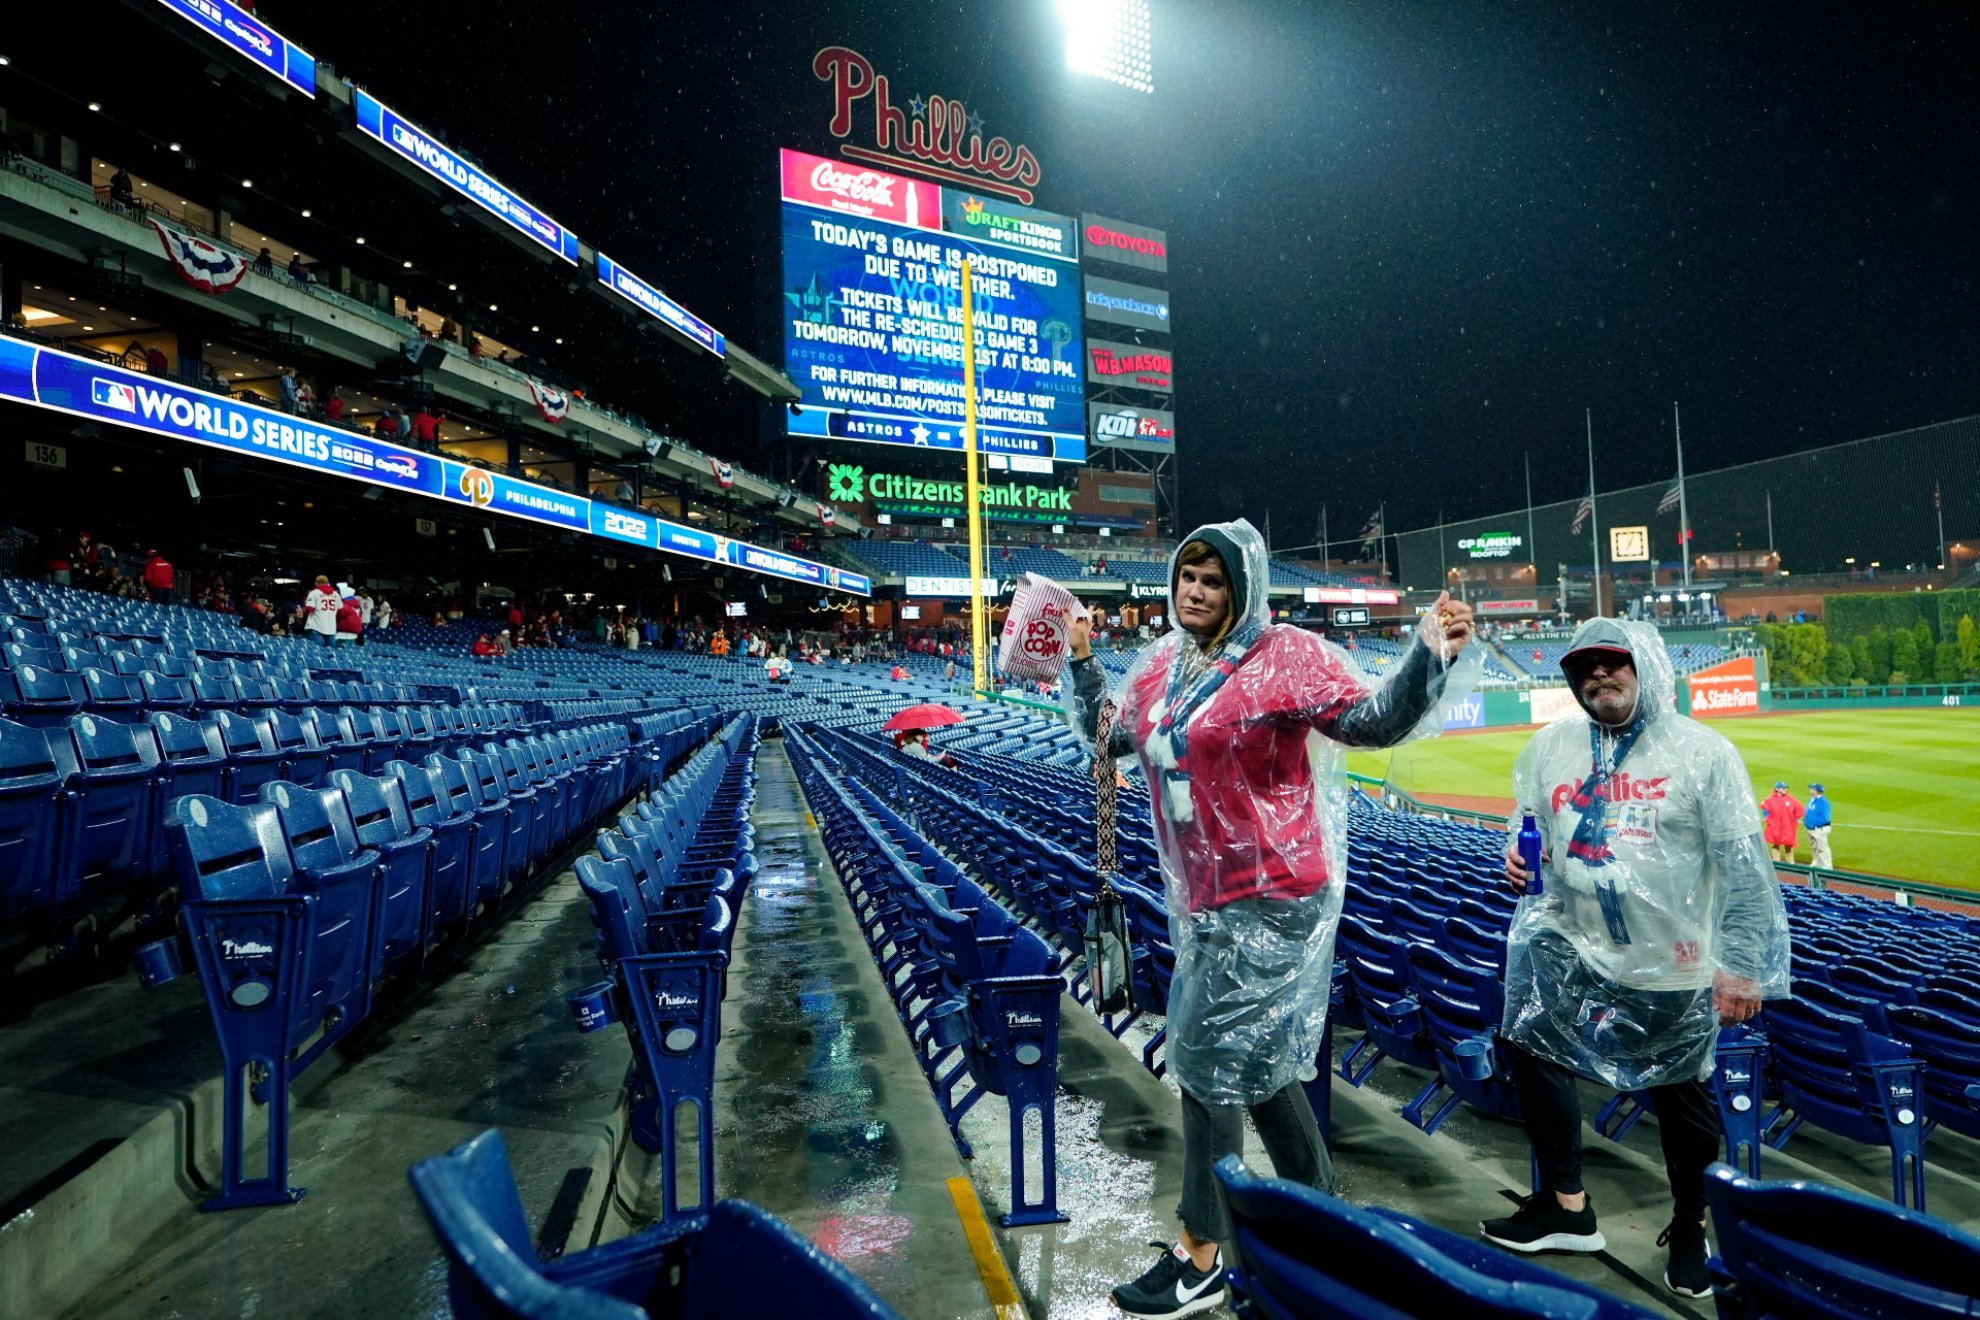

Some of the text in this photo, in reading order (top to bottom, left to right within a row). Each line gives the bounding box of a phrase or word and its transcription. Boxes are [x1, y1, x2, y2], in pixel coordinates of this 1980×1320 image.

[812, 46, 1041, 187] Phillies
[413, 135, 468, 185] WORLD
[468, 173, 510, 213] SERIES
[966, 210, 1062, 240] DRAFTKINGS
[811, 220, 1057, 288] TODAY'S GAME IS POSTPONED
[990, 228, 1061, 252] SPORTSBOOK
[1106, 230, 1167, 258] TOYOTA
[865, 254, 1015, 300] DUE TO WETHER.
[889, 276, 994, 313] WORD
[840, 287, 1037, 336] TICKETS WILL BE VALID FOR
[840, 307, 871, 327] THE
[875, 311, 984, 345] RE-SCHEDULD
[988, 329, 1026, 351] GAME
[1029, 339, 1038, 355] 3
[791, 348, 845, 364] ASTROS
[793, 320, 888, 355] TOMORROW,
[974, 349, 999, 367] 1ST
[1002, 354, 1020, 371] AT
[1022, 356, 1050, 374] 8:00
[1053, 360, 1077, 379] PM.
[811, 365, 838, 383] FOR
[840, 369, 898, 391] FURTHER
[900, 375, 982, 404] INFORMATIO,
[984, 387, 1026, 406] PLEASE
[1028, 395, 1055, 411] VISIT
[1035, 380, 1084, 395] PHILLIES
[821, 385, 1049, 426] WWW.MLB.COM/POSTSASONTICKETS.
[136, 385, 248, 441] WORLD
[252, 418, 331, 462] SERIES
[332, 445, 374, 467] 2022
[847, 421, 903, 437] ASTROS
[1096, 414, 1137, 438] KDI
[34, 444, 58, 465] 136
[983, 434, 1039, 451] PHILLIES
[505, 489, 576, 518] PHILADELPHIA
[869, 473, 964, 503] Citizens
[1026, 485, 1073, 511] Park
[604, 510, 647, 541] 2022
[1470, 550, 1511, 558] ROOFTOP
[908, 579, 993, 593] DENTISTY
[321, 599, 336, 612] 35
[1027, 621, 1055, 640] POP
[1024, 638, 1061, 657] CORN
[1942, 695, 1960, 706] 401
